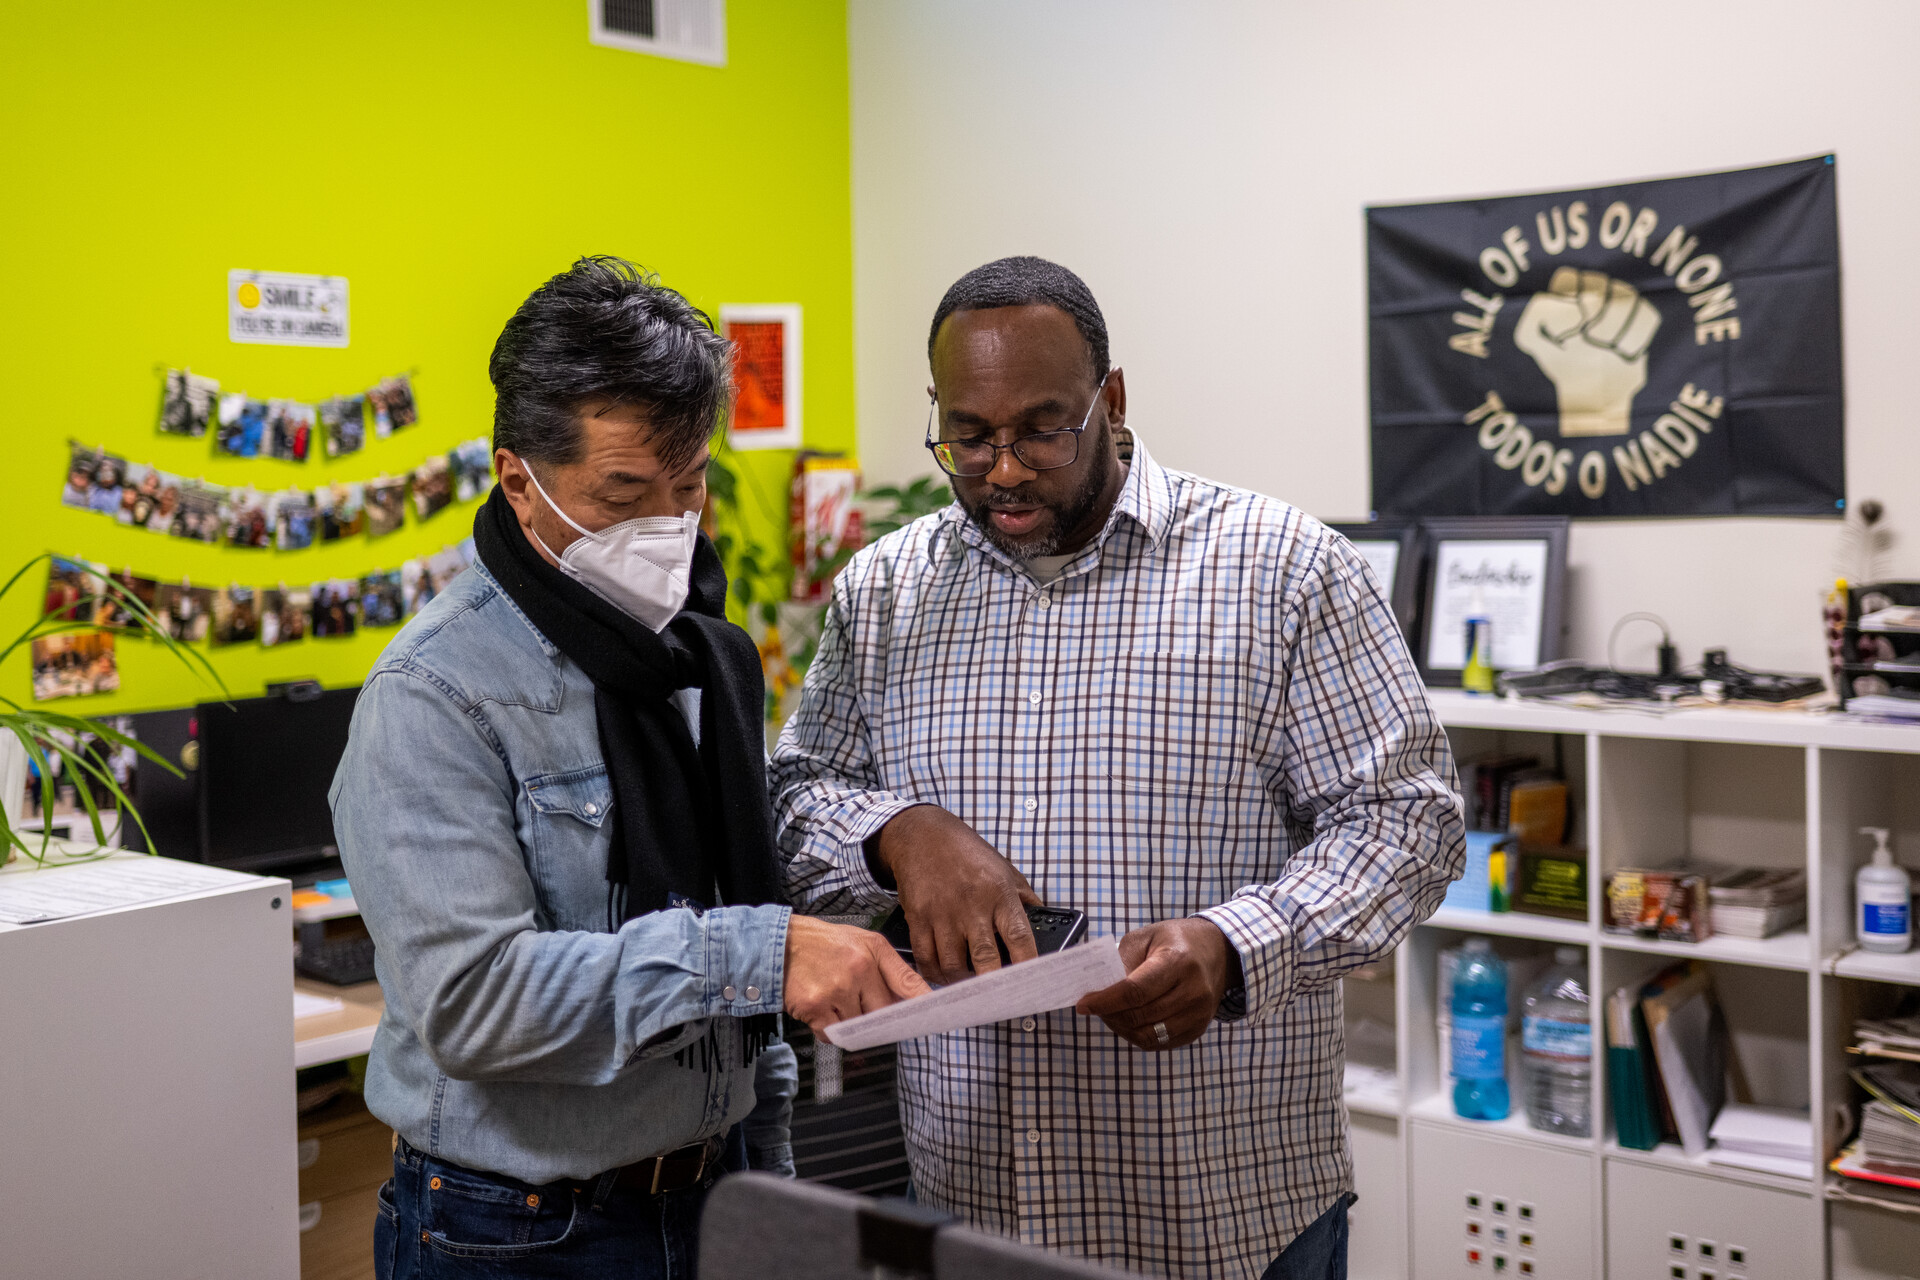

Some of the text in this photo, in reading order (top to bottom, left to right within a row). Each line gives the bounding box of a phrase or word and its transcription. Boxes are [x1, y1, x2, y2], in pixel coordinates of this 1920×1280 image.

[264, 285, 315, 308] SMILE
[1448, 201, 1740, 359] ALL OF US OR NONE
[1465, 382, 1725, 500] TODOS O NADIE
